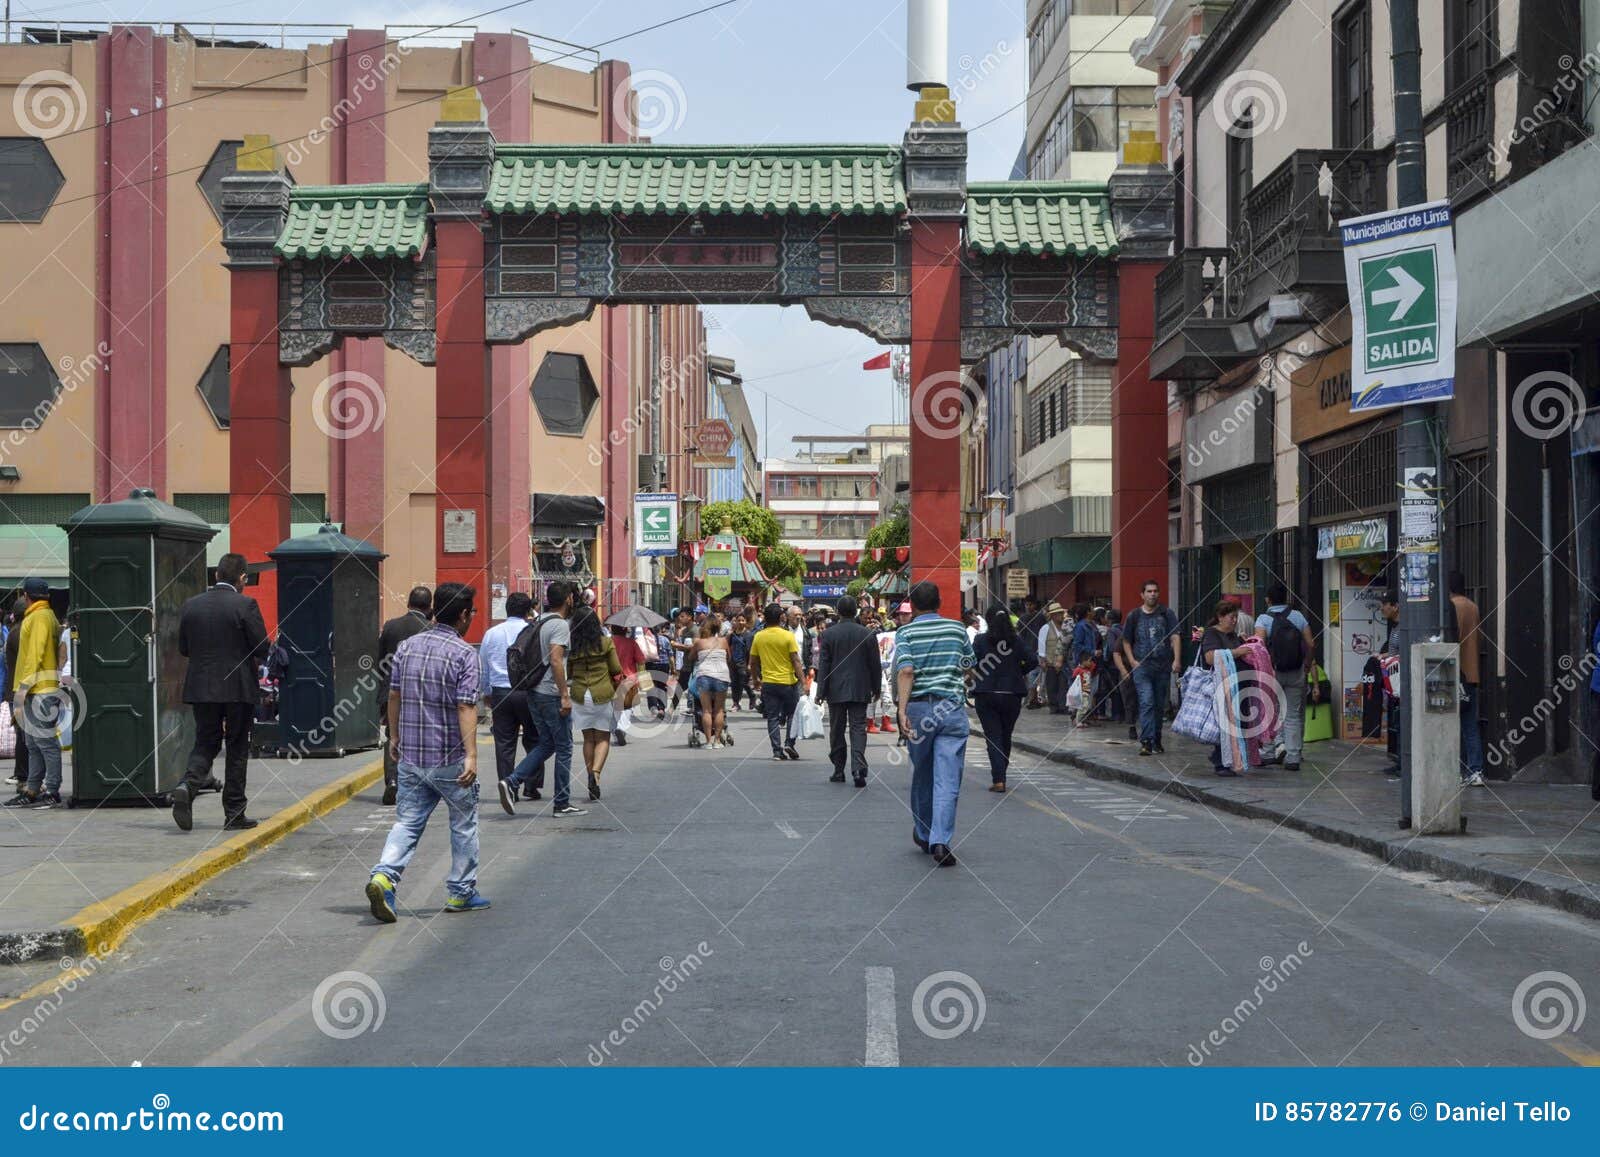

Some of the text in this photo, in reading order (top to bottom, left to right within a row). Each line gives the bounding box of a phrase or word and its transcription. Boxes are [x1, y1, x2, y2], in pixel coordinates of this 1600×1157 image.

[1344, 210, 1449, 242] Municipalidad de Lima
[1370, 337, 1434, 362] SALIDA
[699, 433, 729, 442] CHINA
[1238, 568, 1249, 581] S
